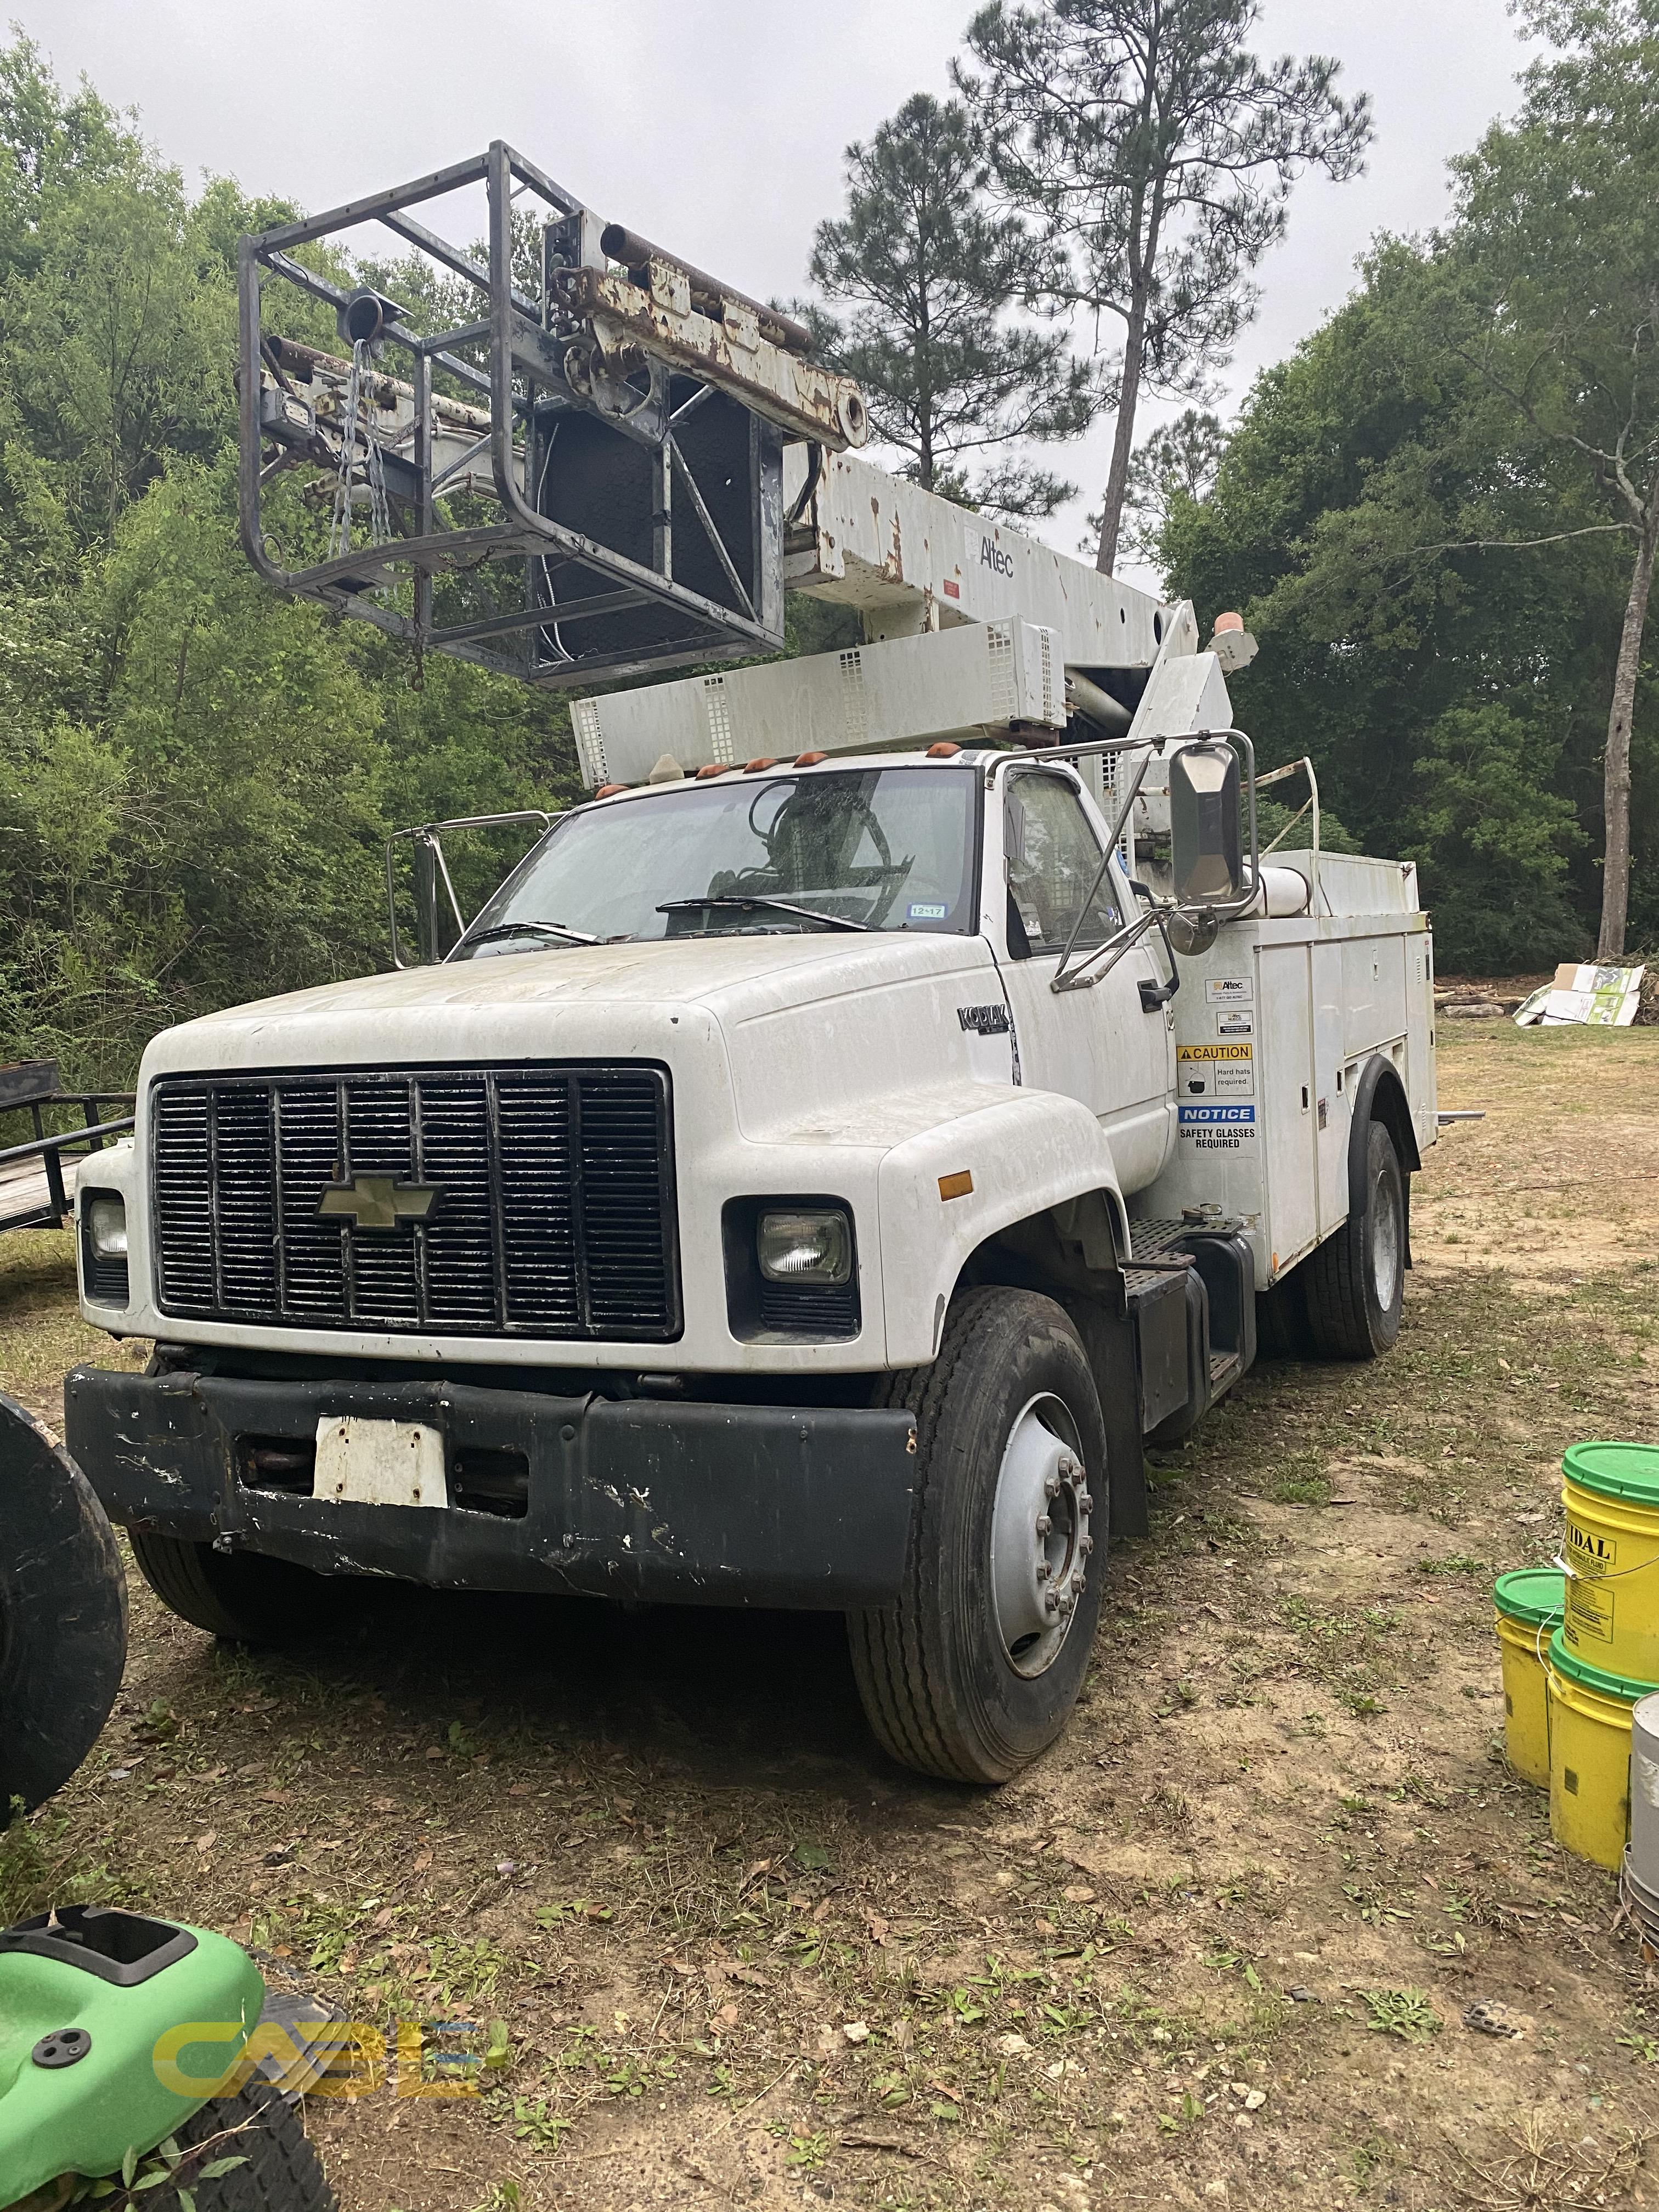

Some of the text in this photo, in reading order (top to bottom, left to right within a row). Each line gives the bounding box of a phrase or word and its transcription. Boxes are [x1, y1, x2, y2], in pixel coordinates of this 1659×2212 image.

[980, 535, 1013, 578] Altec
[1222, 981, 1243, 990] Altec
[957, 1004, 1009, 1031] KODIAK
[1193, 1046, 1249, 1059] CAUTION
[1184, 1109, 1251, 1120] NOTICE
[1180, 1128, 1255, 1138] SAFETY GLASSES
[1196, 1139, 1239, 1148] REQUIRED
[1568, 1523, 1610, 1560] IDAL
